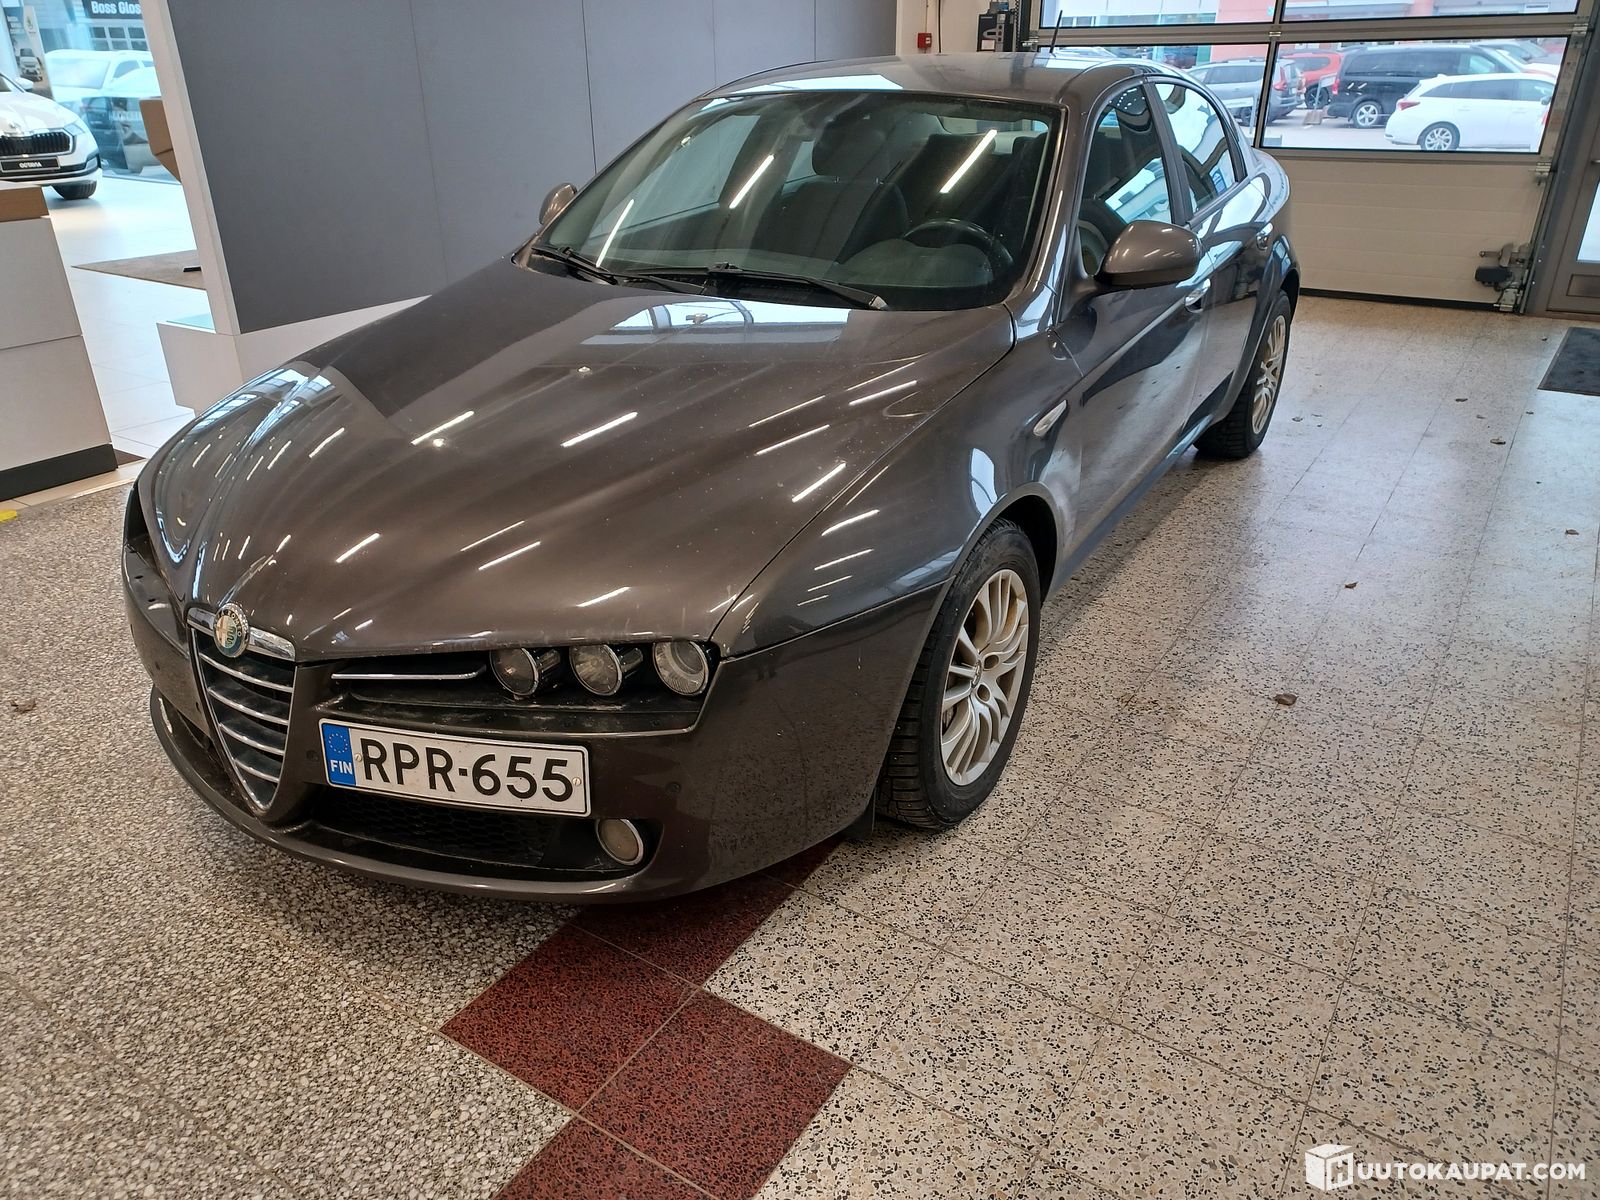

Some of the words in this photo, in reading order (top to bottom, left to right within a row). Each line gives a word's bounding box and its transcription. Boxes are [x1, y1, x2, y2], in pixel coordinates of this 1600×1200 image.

[91, 1, 117, 14] Boss
[330, 760, 353, 775] FIN
[360, 738, 573, 802] RPR-655
